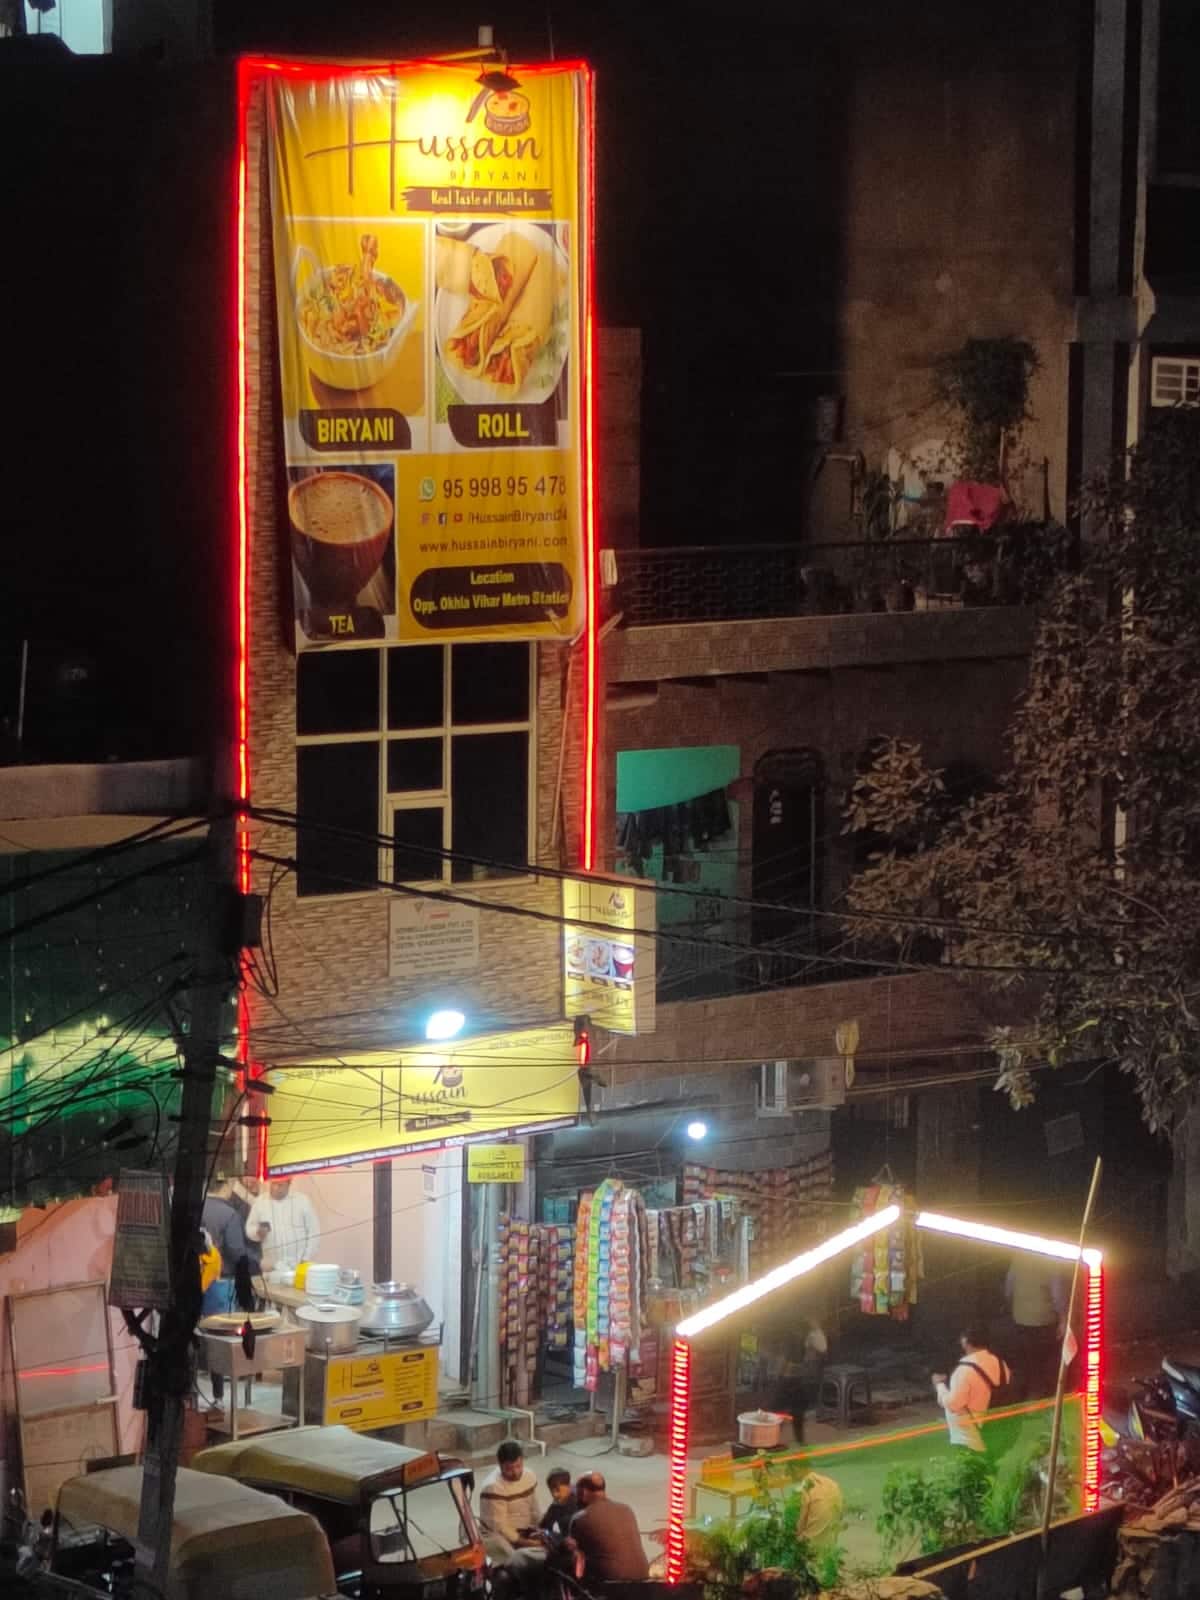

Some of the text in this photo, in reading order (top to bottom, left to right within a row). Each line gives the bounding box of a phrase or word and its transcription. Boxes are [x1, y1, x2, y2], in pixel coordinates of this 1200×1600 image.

[304, 66, 542, 211] Hussain
[450, 170, 539, 182] BIRYANI
[431, 189, 453, 206] Real
[455, 190, 480, 206] Taste
[482, 190, 493, 206] of
[316, 416, 395, 444] BIRYANI
[477, 412, 529, 439] ROLL
[442, 478, 464, 499] 95
[468, 477, 502, 497] 998
[506, 476, 528, 496] 95
[470, 570, 515, 585] Location
[413, 598, 438, 615] Opp.
[440, 595, 470, 611] Okhla
[472, 593, 500, 609] Vihar
[502, 592, 530, 607] Metro
[329, 614, 355, 634] TEA
